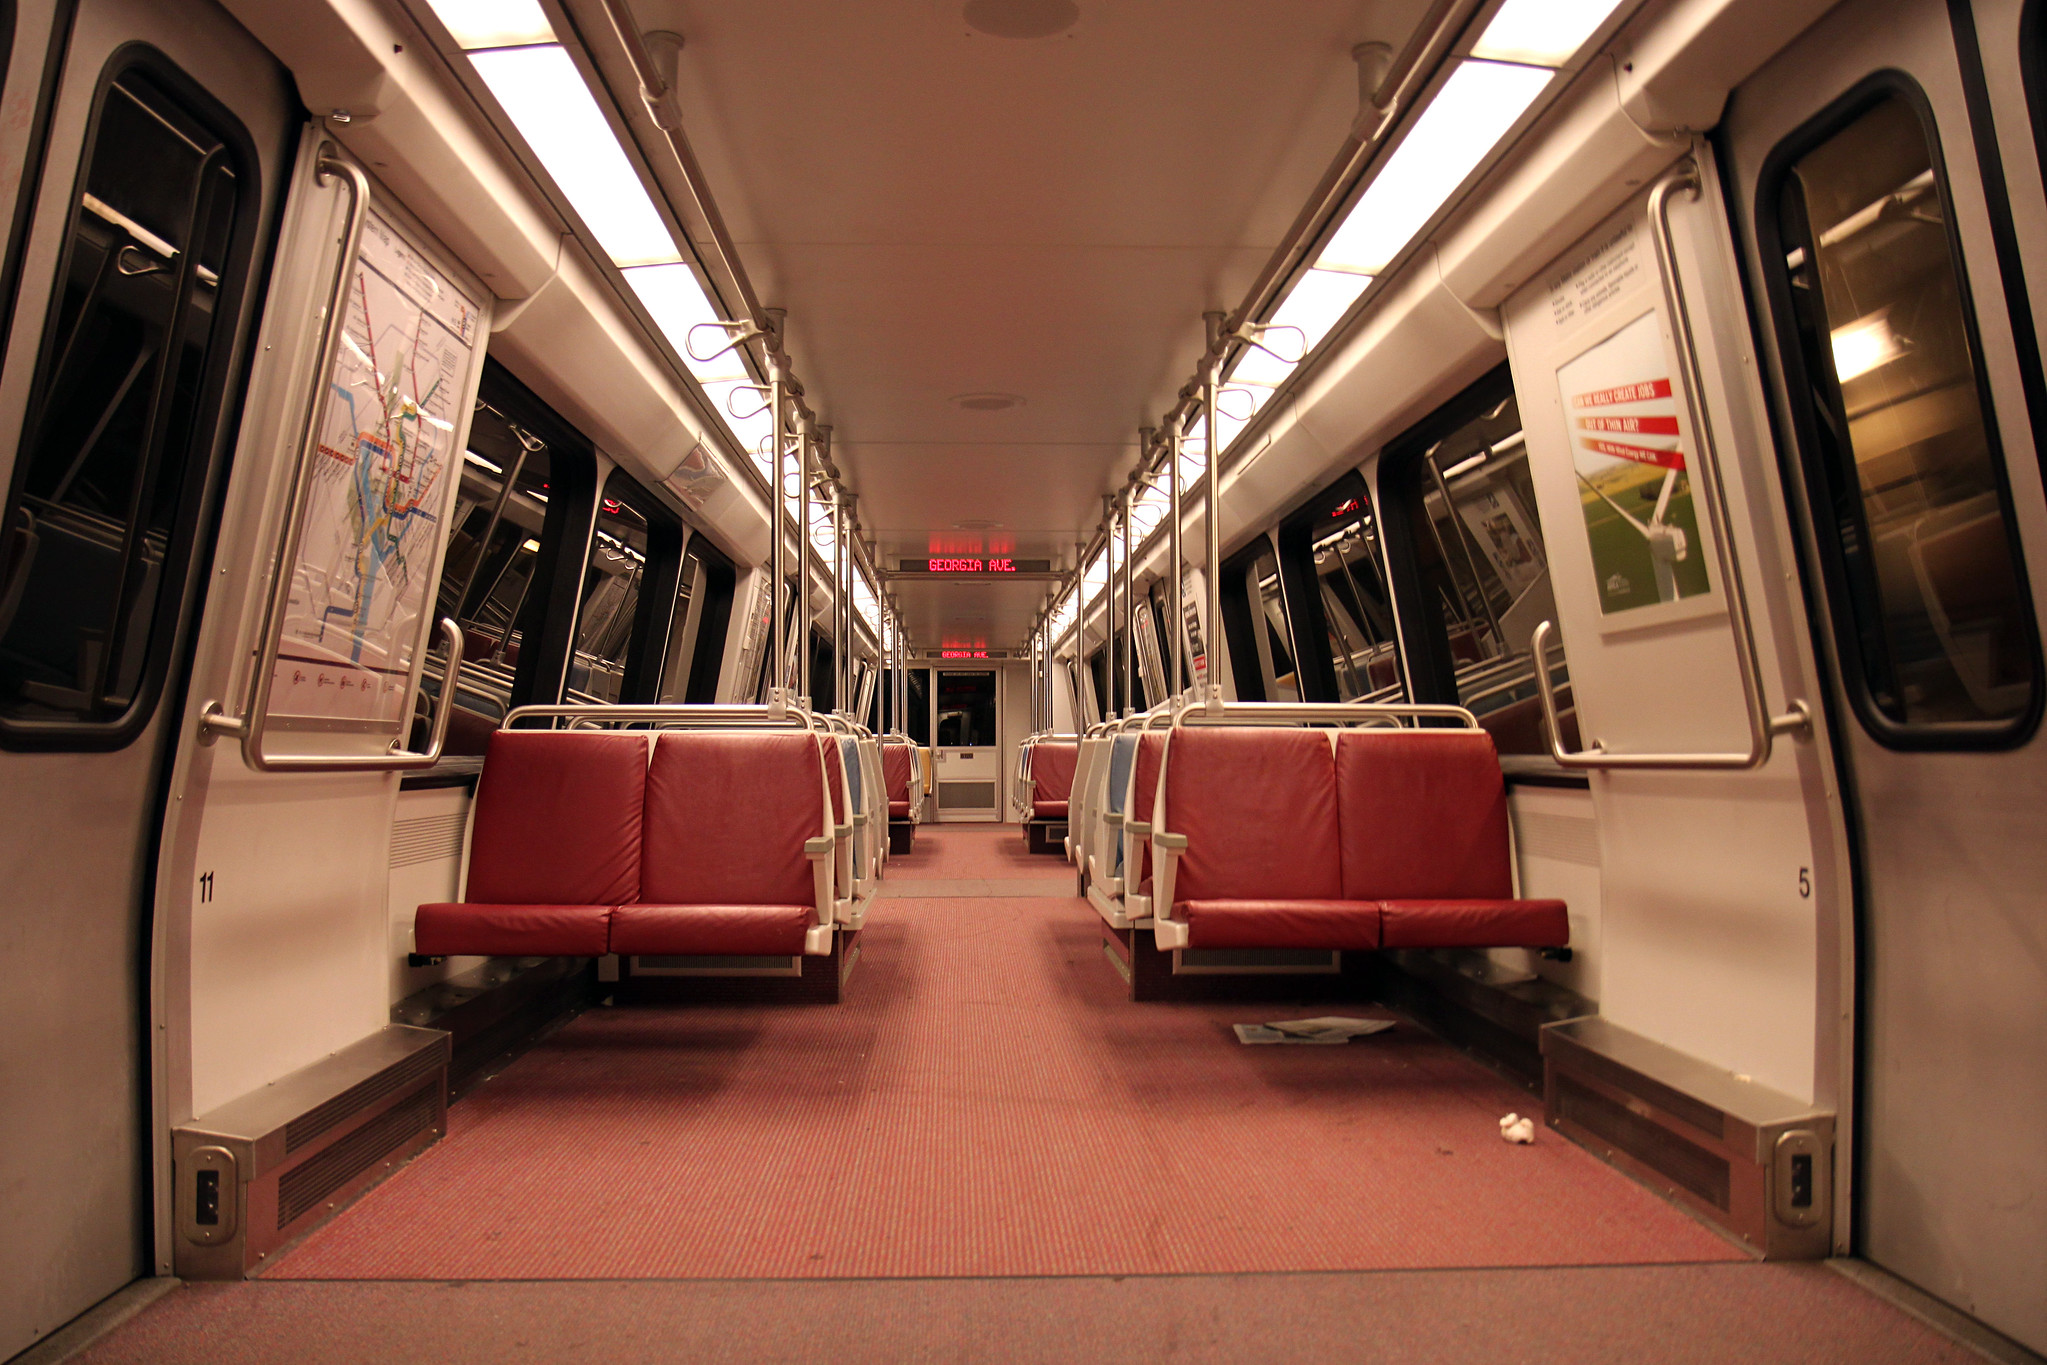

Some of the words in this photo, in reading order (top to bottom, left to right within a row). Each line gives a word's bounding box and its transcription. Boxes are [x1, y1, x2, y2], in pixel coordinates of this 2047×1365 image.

[1613, 386, 1637, 403] CREATE
[1637, 382, 1656, 400] JOBS
[1585, 418, 1597, 431] OUT
[1596, 418, 1605, 431] OF
[1605, 418, 1622, 432] THIN
[1622, 418, 1640, 432] AIR?
[929, 558, 983, 571] GEORGIA
[988, 558, 1016, 571] AVE.
[941, 650, 972, 659] GEORGIA
[973, 651, 989, 659] AVE.
[200, 870, 214, 904] 11
[1799, 867, 1810, 899] 5
